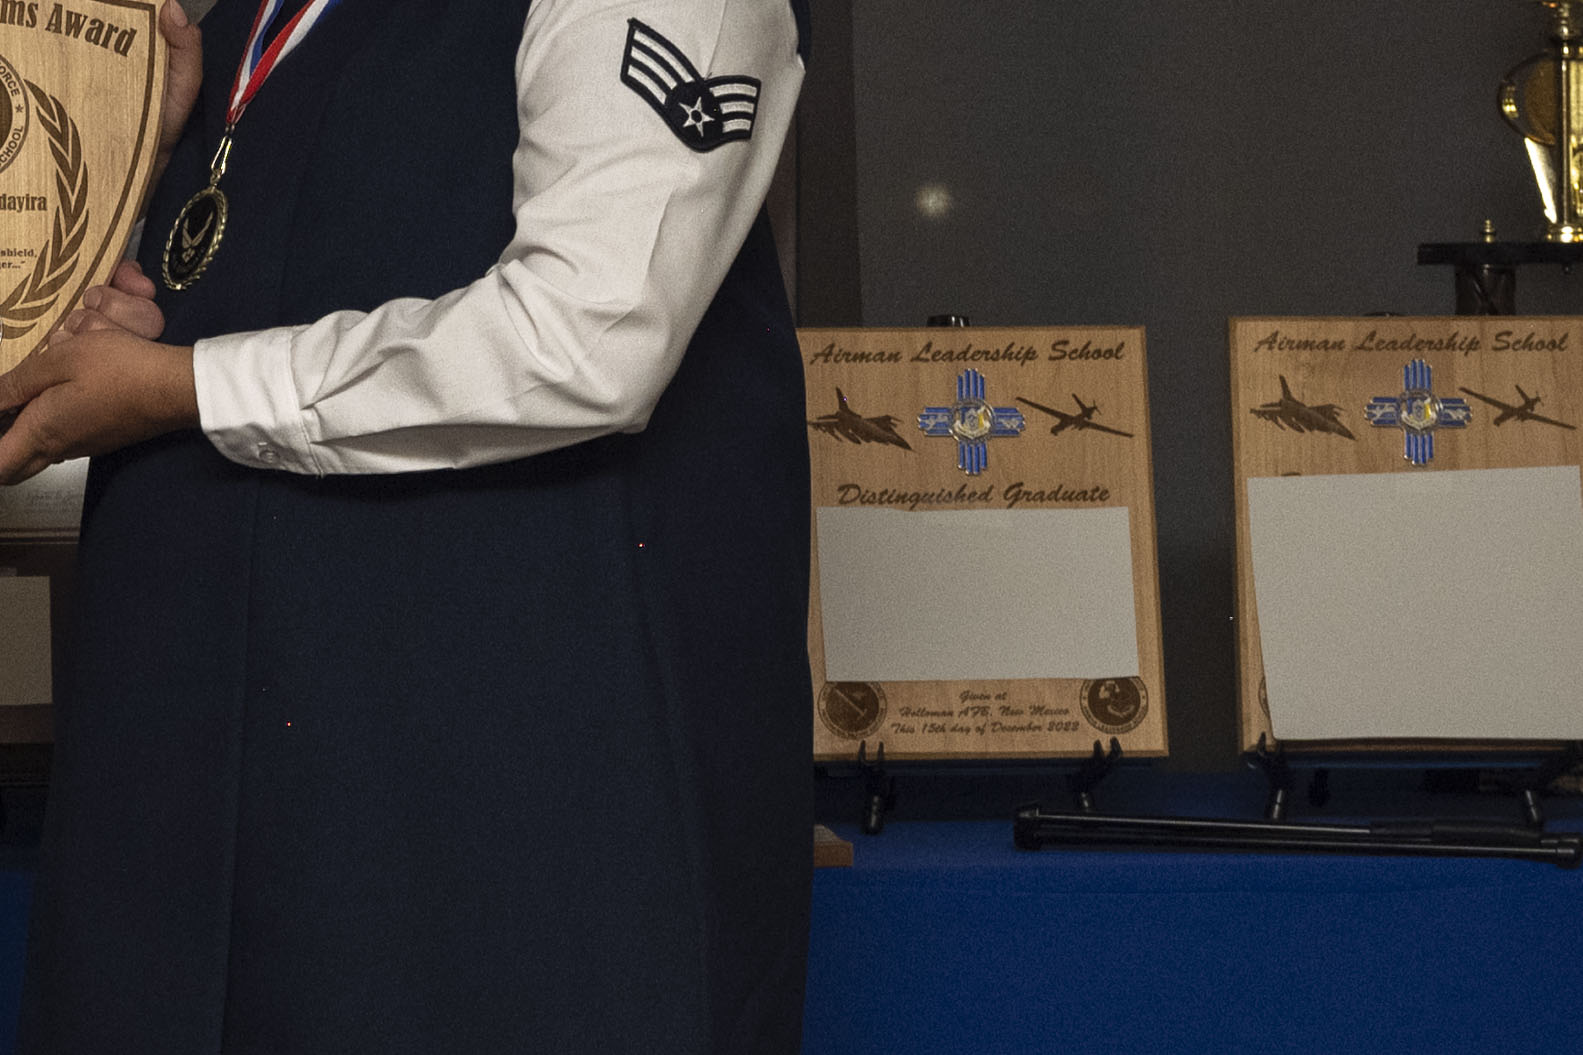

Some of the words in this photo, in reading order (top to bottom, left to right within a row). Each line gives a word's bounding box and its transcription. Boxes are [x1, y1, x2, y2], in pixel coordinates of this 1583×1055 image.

[45, 2, 137, 58] Award
[810, 344, 903, 366] Airman
[910, 341, 1039, 367] Leadership
[1048, 340, 1125, 361] School
[1254, 330, 1346, 353] Airman
[1356, 330, 1481, 356] Leadership
[1491, 330, 1569, 352] School
[837, 484, 993, 510] Distinguished
[1004, 482, 1110, 509] Graduate
[959, 690, 991, 703] Given
[995, 692, 1007, 701] at
[899, 706, 954, 717] Holloman
[999, 705, 1024, 716] New
[1029, 704, 1070, 716] Mexico
[891, 722, 915, 734] This
[950, 724, 971, 735] day
[975, 721, 986, 736] of
[991, 721, 1042, 733] December
